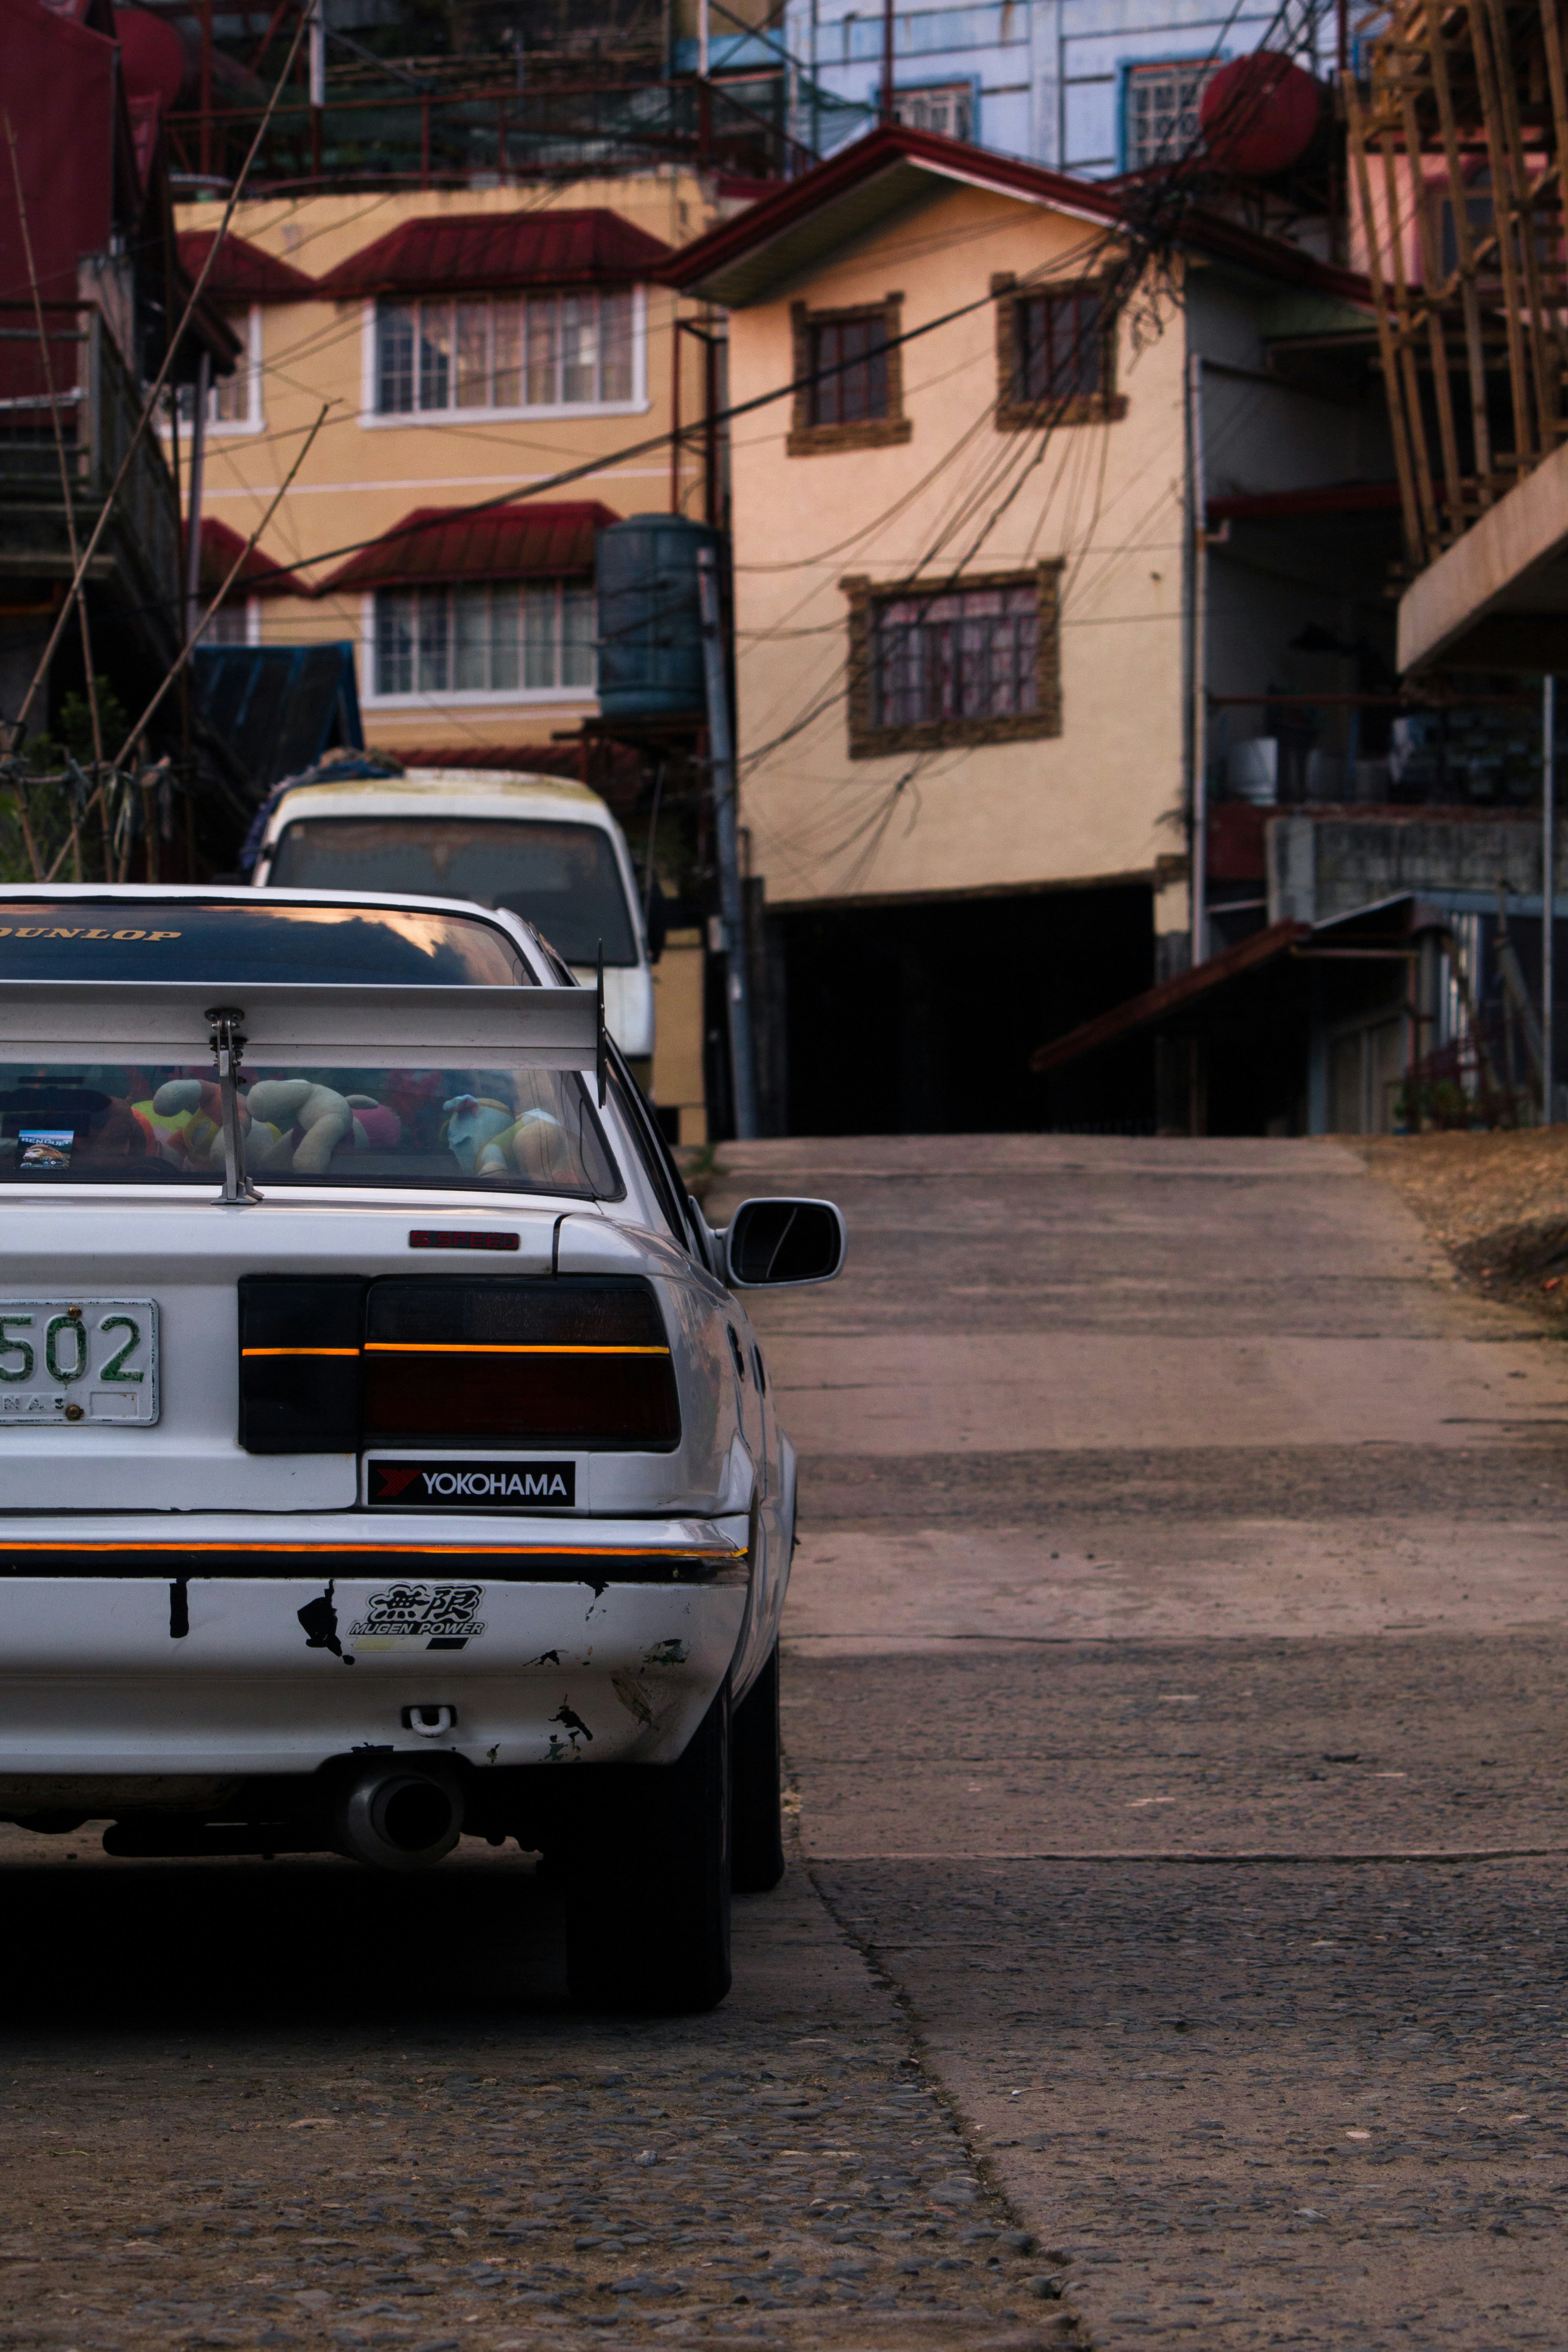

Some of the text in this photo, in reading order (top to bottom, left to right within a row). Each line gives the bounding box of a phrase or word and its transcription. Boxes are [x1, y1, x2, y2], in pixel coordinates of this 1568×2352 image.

[21, 1138, 72, 1146] BENGUET
[411, 1232, 517, 1248] 5 SPEED
[0, 1314, 145, 1383] 502
[422, 1473, 567, 1495] YOKOHAMA
[368, 1584, 484, 1622] 無限
[350, 1622, 485, 1635] MUGEN POWER
